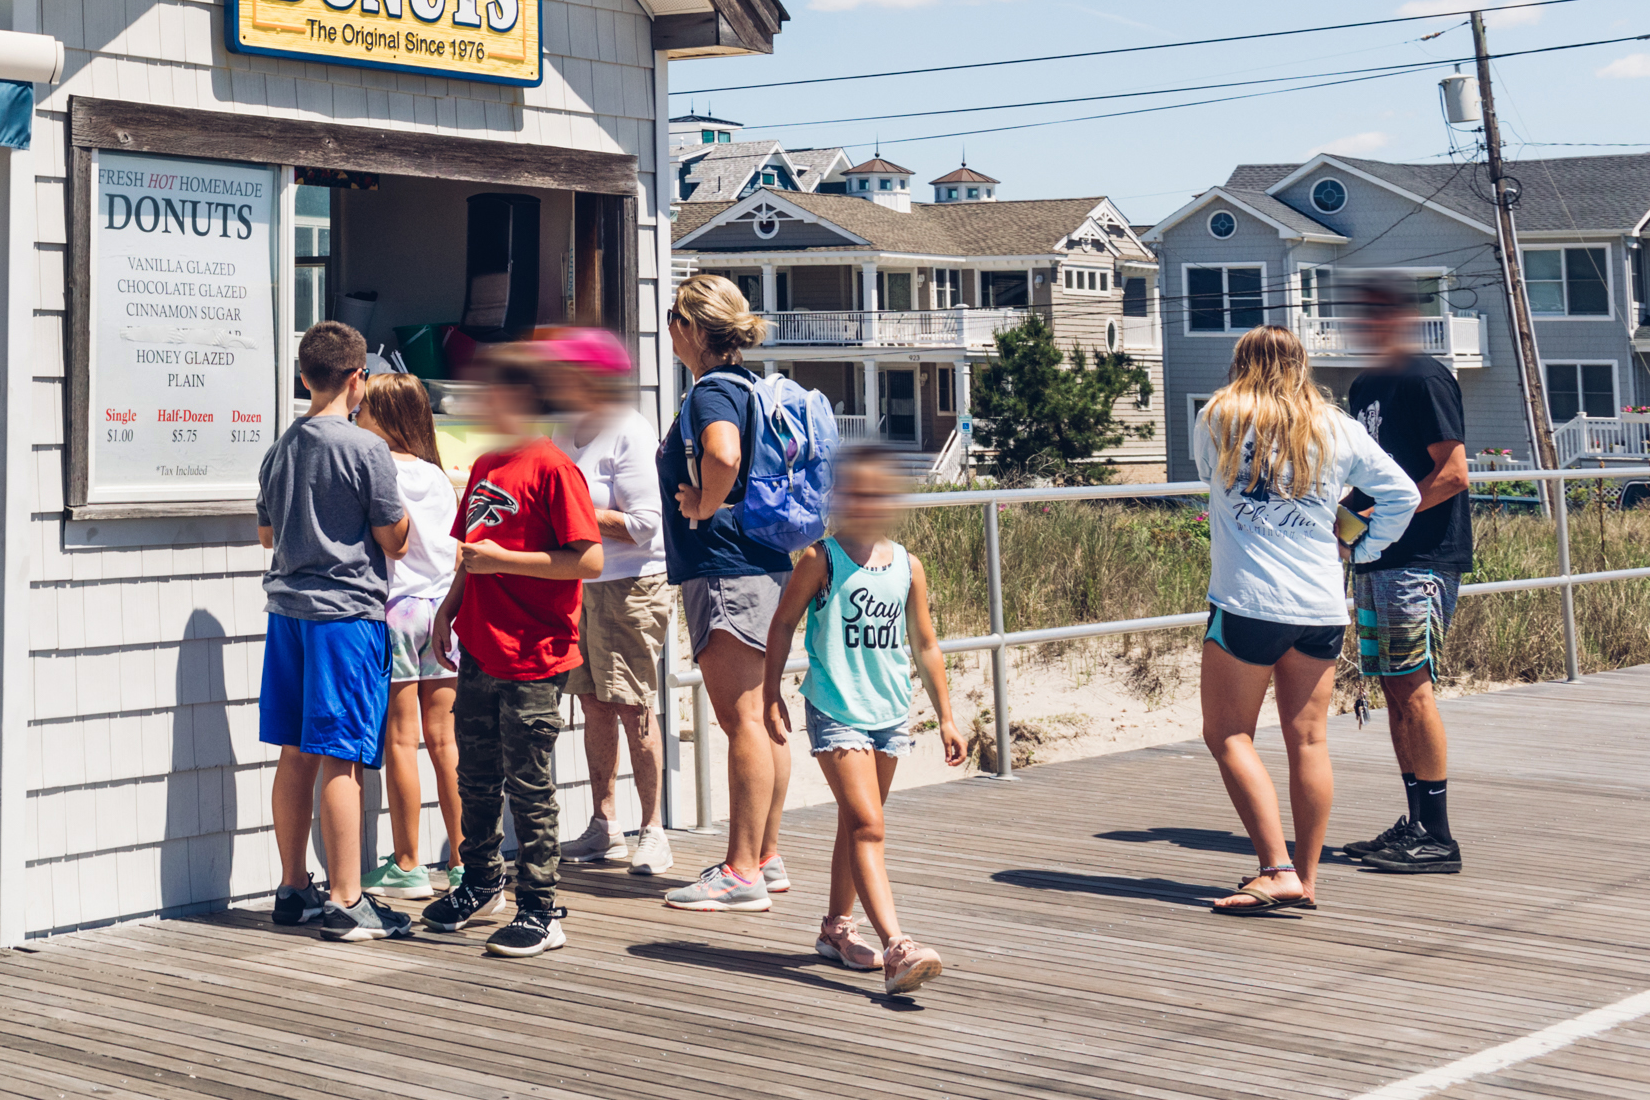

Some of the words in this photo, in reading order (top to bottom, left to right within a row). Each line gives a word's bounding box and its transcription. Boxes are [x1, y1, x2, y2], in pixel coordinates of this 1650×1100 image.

[307, 18, 337, 43] The
[342, 23, 400, 51] Original
[405, 31, 445, 55] Since
[451, 38, 485, 60] 1976
[98, 168, 145, 188] FRESH
[147, 173, 178, 190] HOT
[179, 176, 263, 198] HOMEMADE
[104, 193, 253, 240] DONUTS
[127, 256, 184, 273] VANILLA
[186, 260, 236, 276] GLAZED
[117, 278, 196, 296] CHOCOLATE
[198, 283, 247, 299] GLAZED
[126, 302, 198, 319] CINNAMON
[200, 305, 242, 321] SUGAR
[136, 349, 181, 364] HONEY
[184, 351, 235, 366] GLAZED
[167, 373, 205, 388] PLAIN
[105, 408, 137, 425] Single
[157, 409, 214, 423] Half-Dozen
[231, 410, 262, 423] Dozen
[107, 428, 134, 443] $1.00
[171, 429, 197, 443] $5.75
[230, 430, 261, 443] $11.25
[175, 465, 208, 477] Included
[842, 587, 902, 628] Stay
[845, 624, 899, 649] COOL
